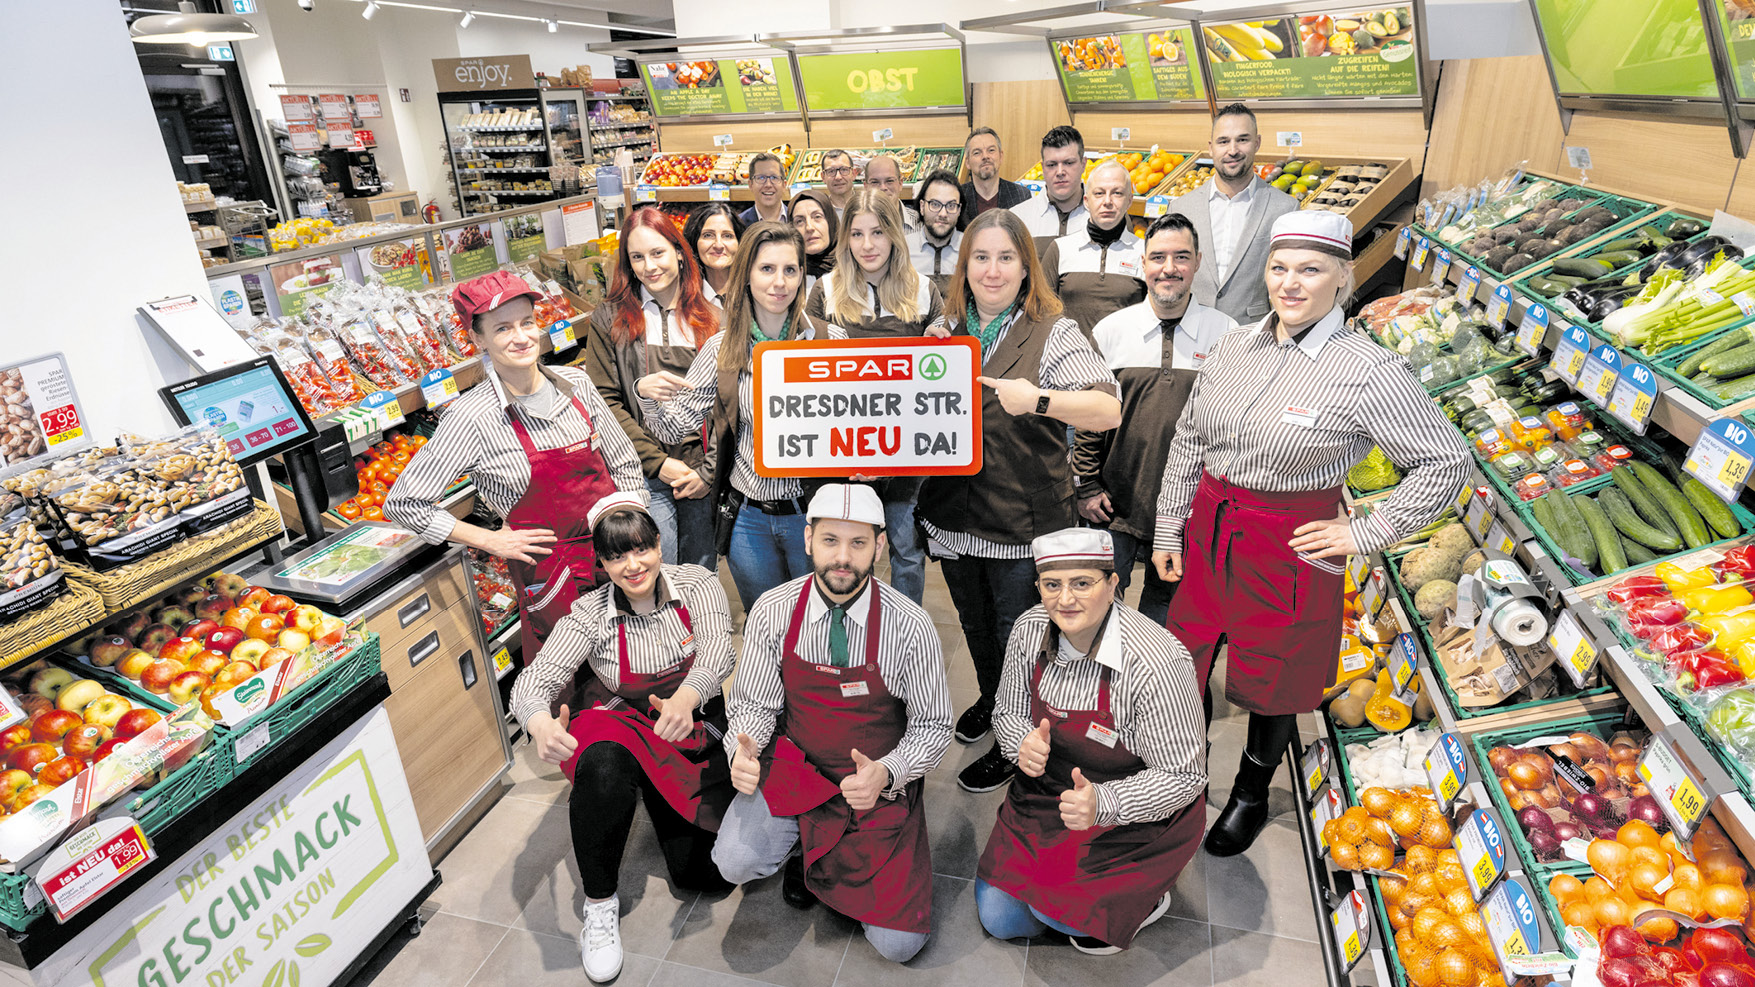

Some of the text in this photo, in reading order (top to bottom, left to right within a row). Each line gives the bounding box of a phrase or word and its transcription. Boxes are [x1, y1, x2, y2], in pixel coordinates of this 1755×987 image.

[1337, 56, 1379, 64] ZUGREIFEN
[455, 64, 512, 88] enjoy.
[846, 67, 919, 93] OBST
[1572, 328, 1584, 343] BIO
[1601, 348, 1615, 364] BIO
[429, 370, 442, 381] BIO
[809, 359, 910, 378] SPAR
[1633, 366, 1649, 384] BIO
[368, 393, 383, 405] BIO
[769, 392, 967, 418] DRESDNER STR.
[43, 410, 77, 433] 2.99
[54, 429, 78, 443] -25%
[779, 426, 957, 457] IST NEU DA!
[1724, 423, 1747, 445] BIO
[1726, 459, 1745, 479] 1,39
[121, 528, 179, 555] ARACHIDI GIANT SPECIAL
[26, 593, 42, 602] GIANT
[1405, 637, 1413, 656] BIO
[1577, 646, 1591, 666] 2,99
[1449, 742, 1462, 764] BIO
[1444, 776, 1456, 796] 3,99
[1558, 761, 1590, 791] BIO-ZWIEBEL
[1679, 788, 1699, 816] 1,99
[69, 831, 96, 851] GESCHMACK
[1484, 821, 1499, 847] BIO
[114, 845, 138, 865] 1.99
[175, 793, 296, 904] DER BESTE
[59, 838, 125, 886] ist NEU da!
[1478, 859, 1492, 883] 3,99
[137, 793, 361, 987] GESCHMACK
[1516, 893, 1533, 925] BIO
[205, 867, 335, 987] DER SAISON
[1510, 938, 1525, 955] 1,3
